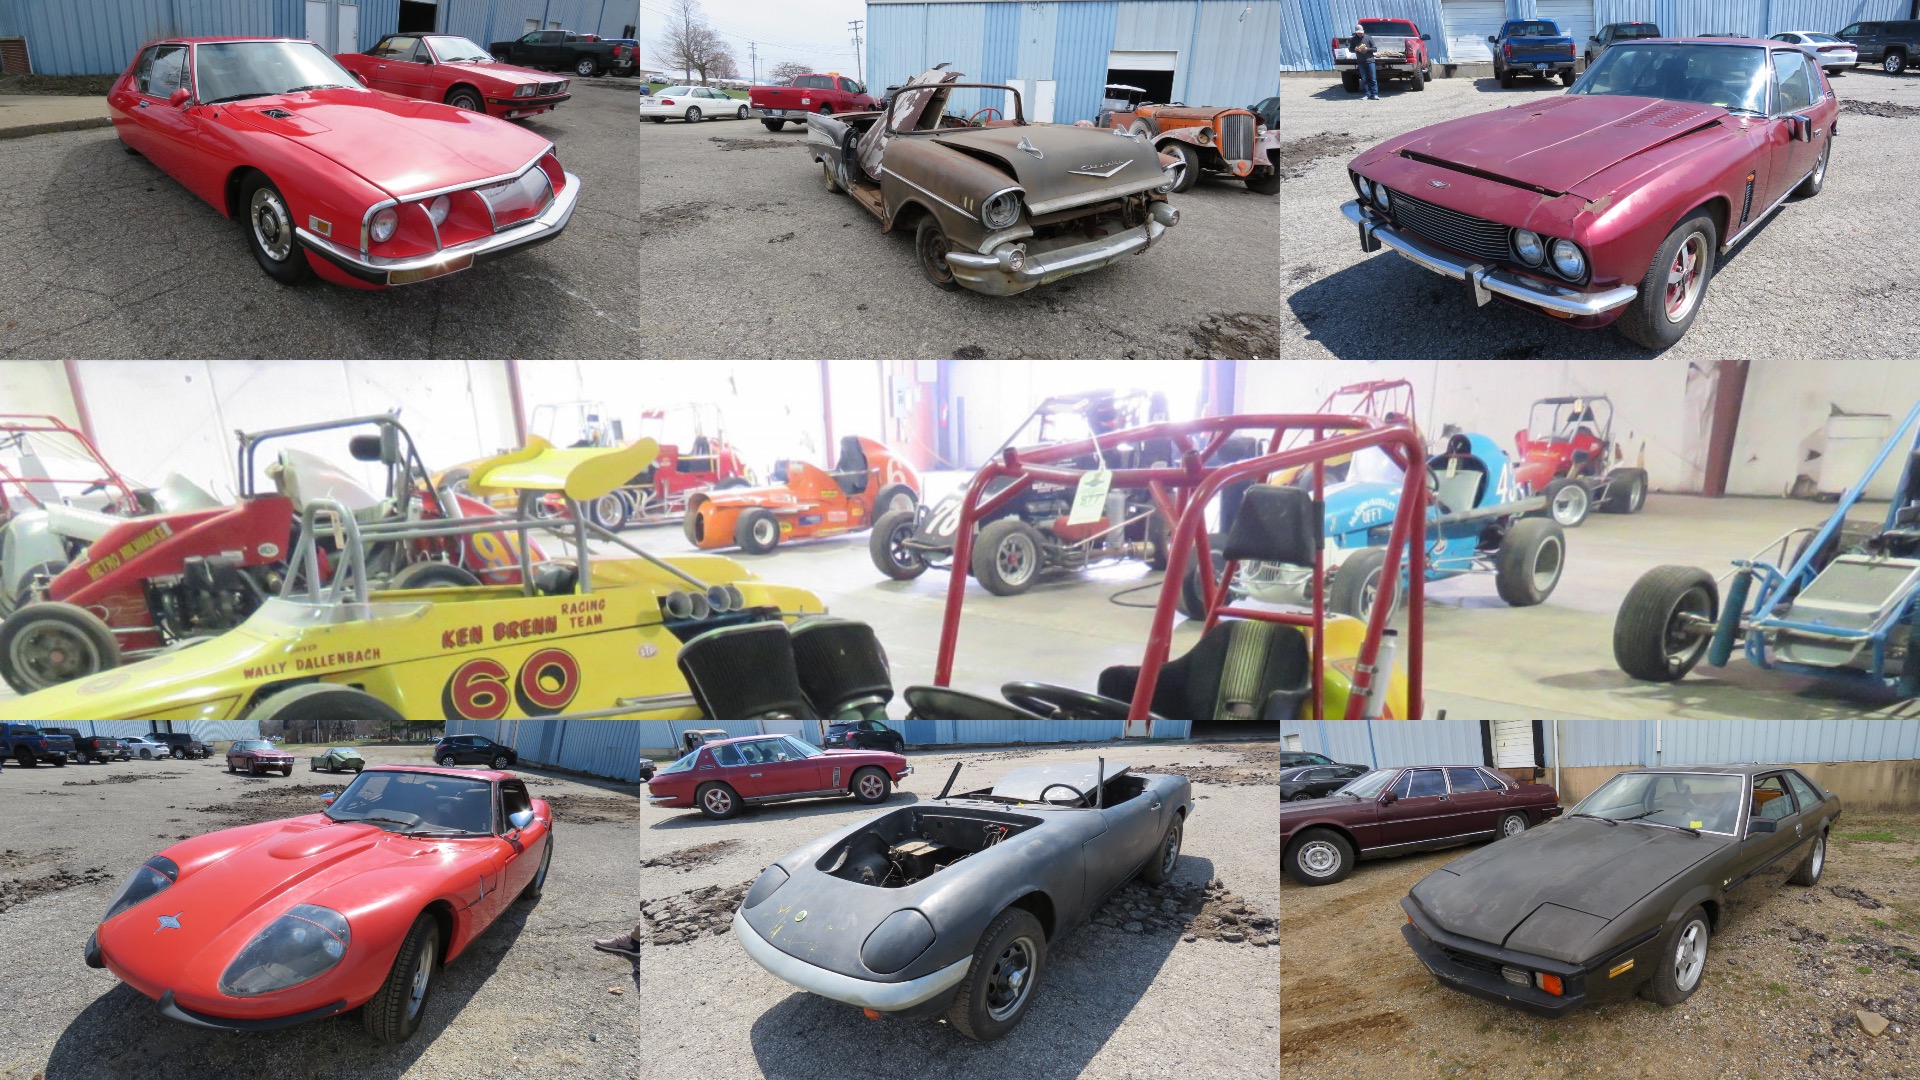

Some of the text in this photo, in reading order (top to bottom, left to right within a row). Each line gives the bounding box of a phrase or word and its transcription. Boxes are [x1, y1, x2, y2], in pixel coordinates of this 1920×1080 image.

[87, 553, 121, 581] METRO
[561, 599, 606, 615] RACING
[569, 613, 604, 629] TEAM
[441, 615, 558, 649] KEN BRENN
[243, 648, 381, 679] WALLY DALLENBACH
[441, 647, 581, 720] 60
